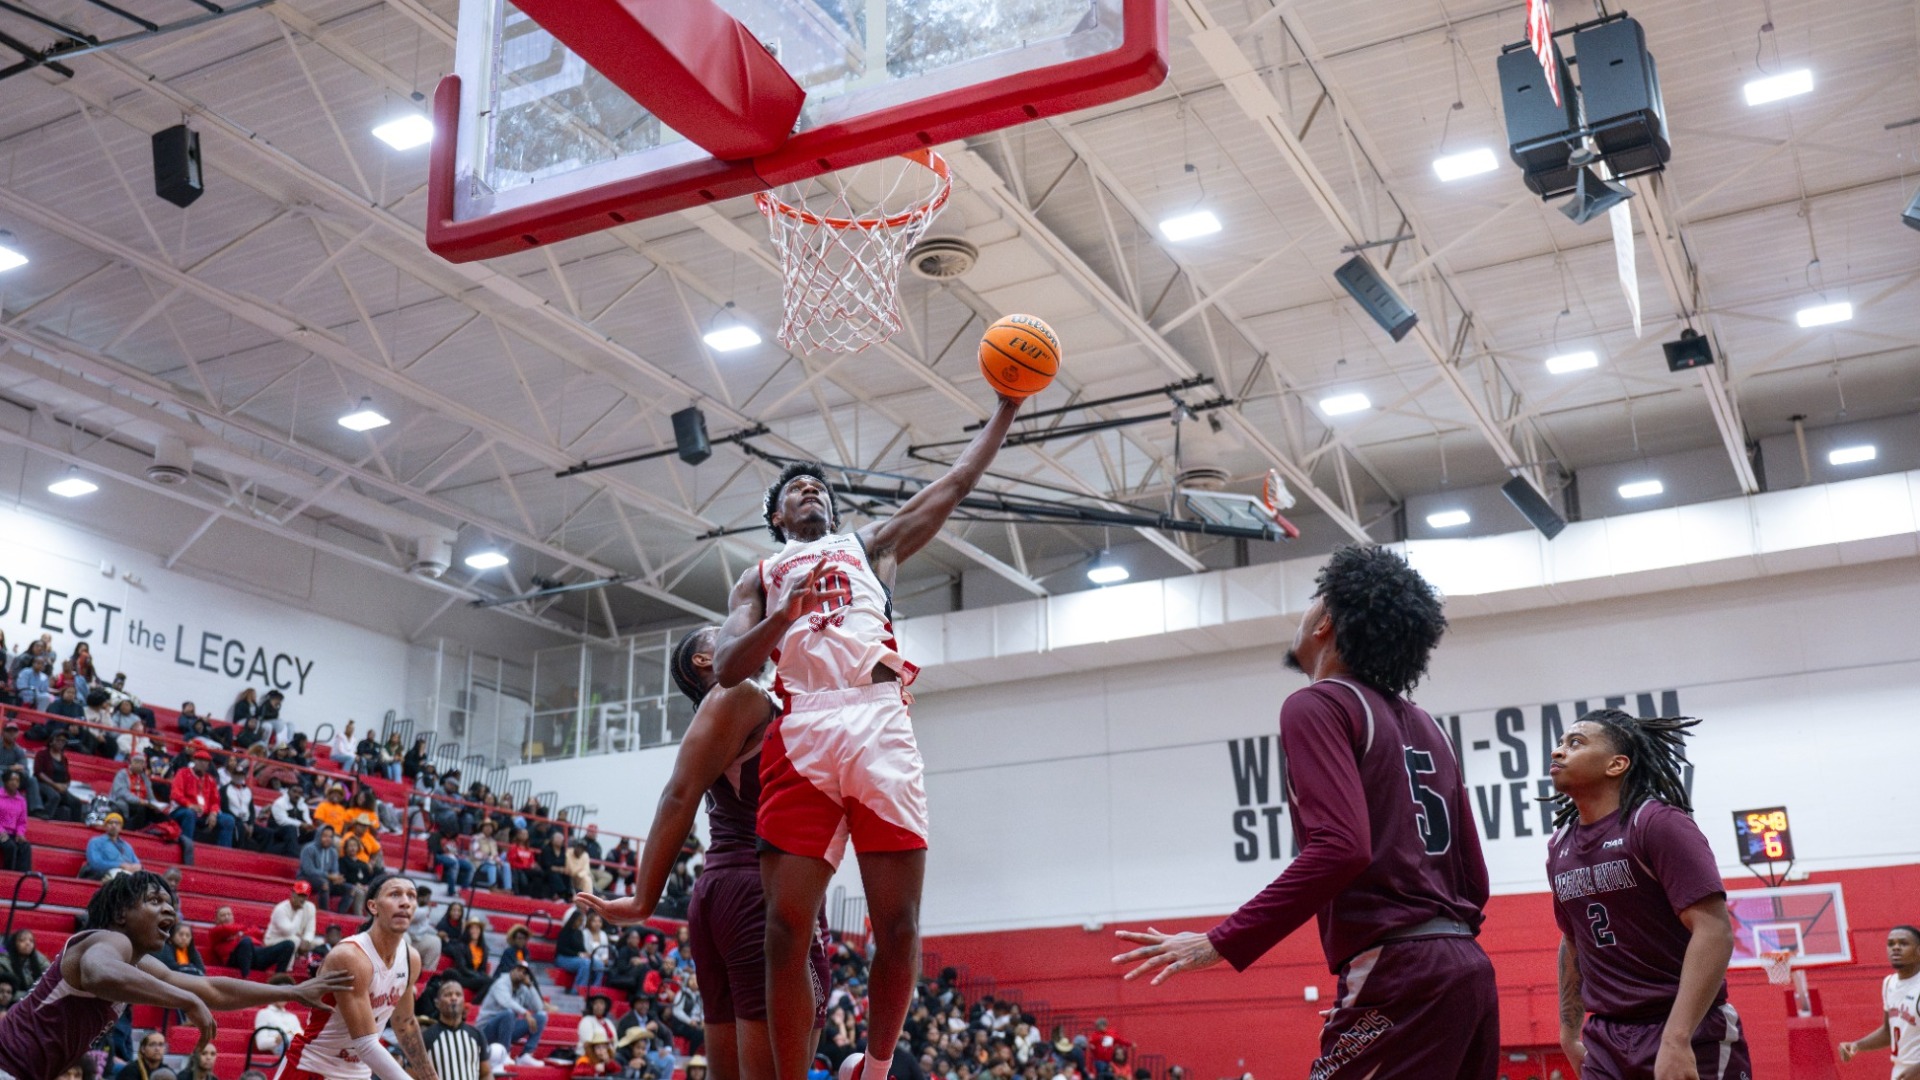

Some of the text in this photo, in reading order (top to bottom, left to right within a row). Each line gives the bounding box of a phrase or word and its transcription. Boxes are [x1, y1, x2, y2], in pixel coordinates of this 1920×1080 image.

[1009, 336, 1043, 360] EVO
[128, 618, 166, 652] the
[174, 624, 314, 695] LEGACY
[1403, 744, 1451, 856] 5
[1764, 831, 1783, 857] 6
[1586, 902, 1617, 948] 2
[1310, 1010, 1394, 1080] ANTHERS
